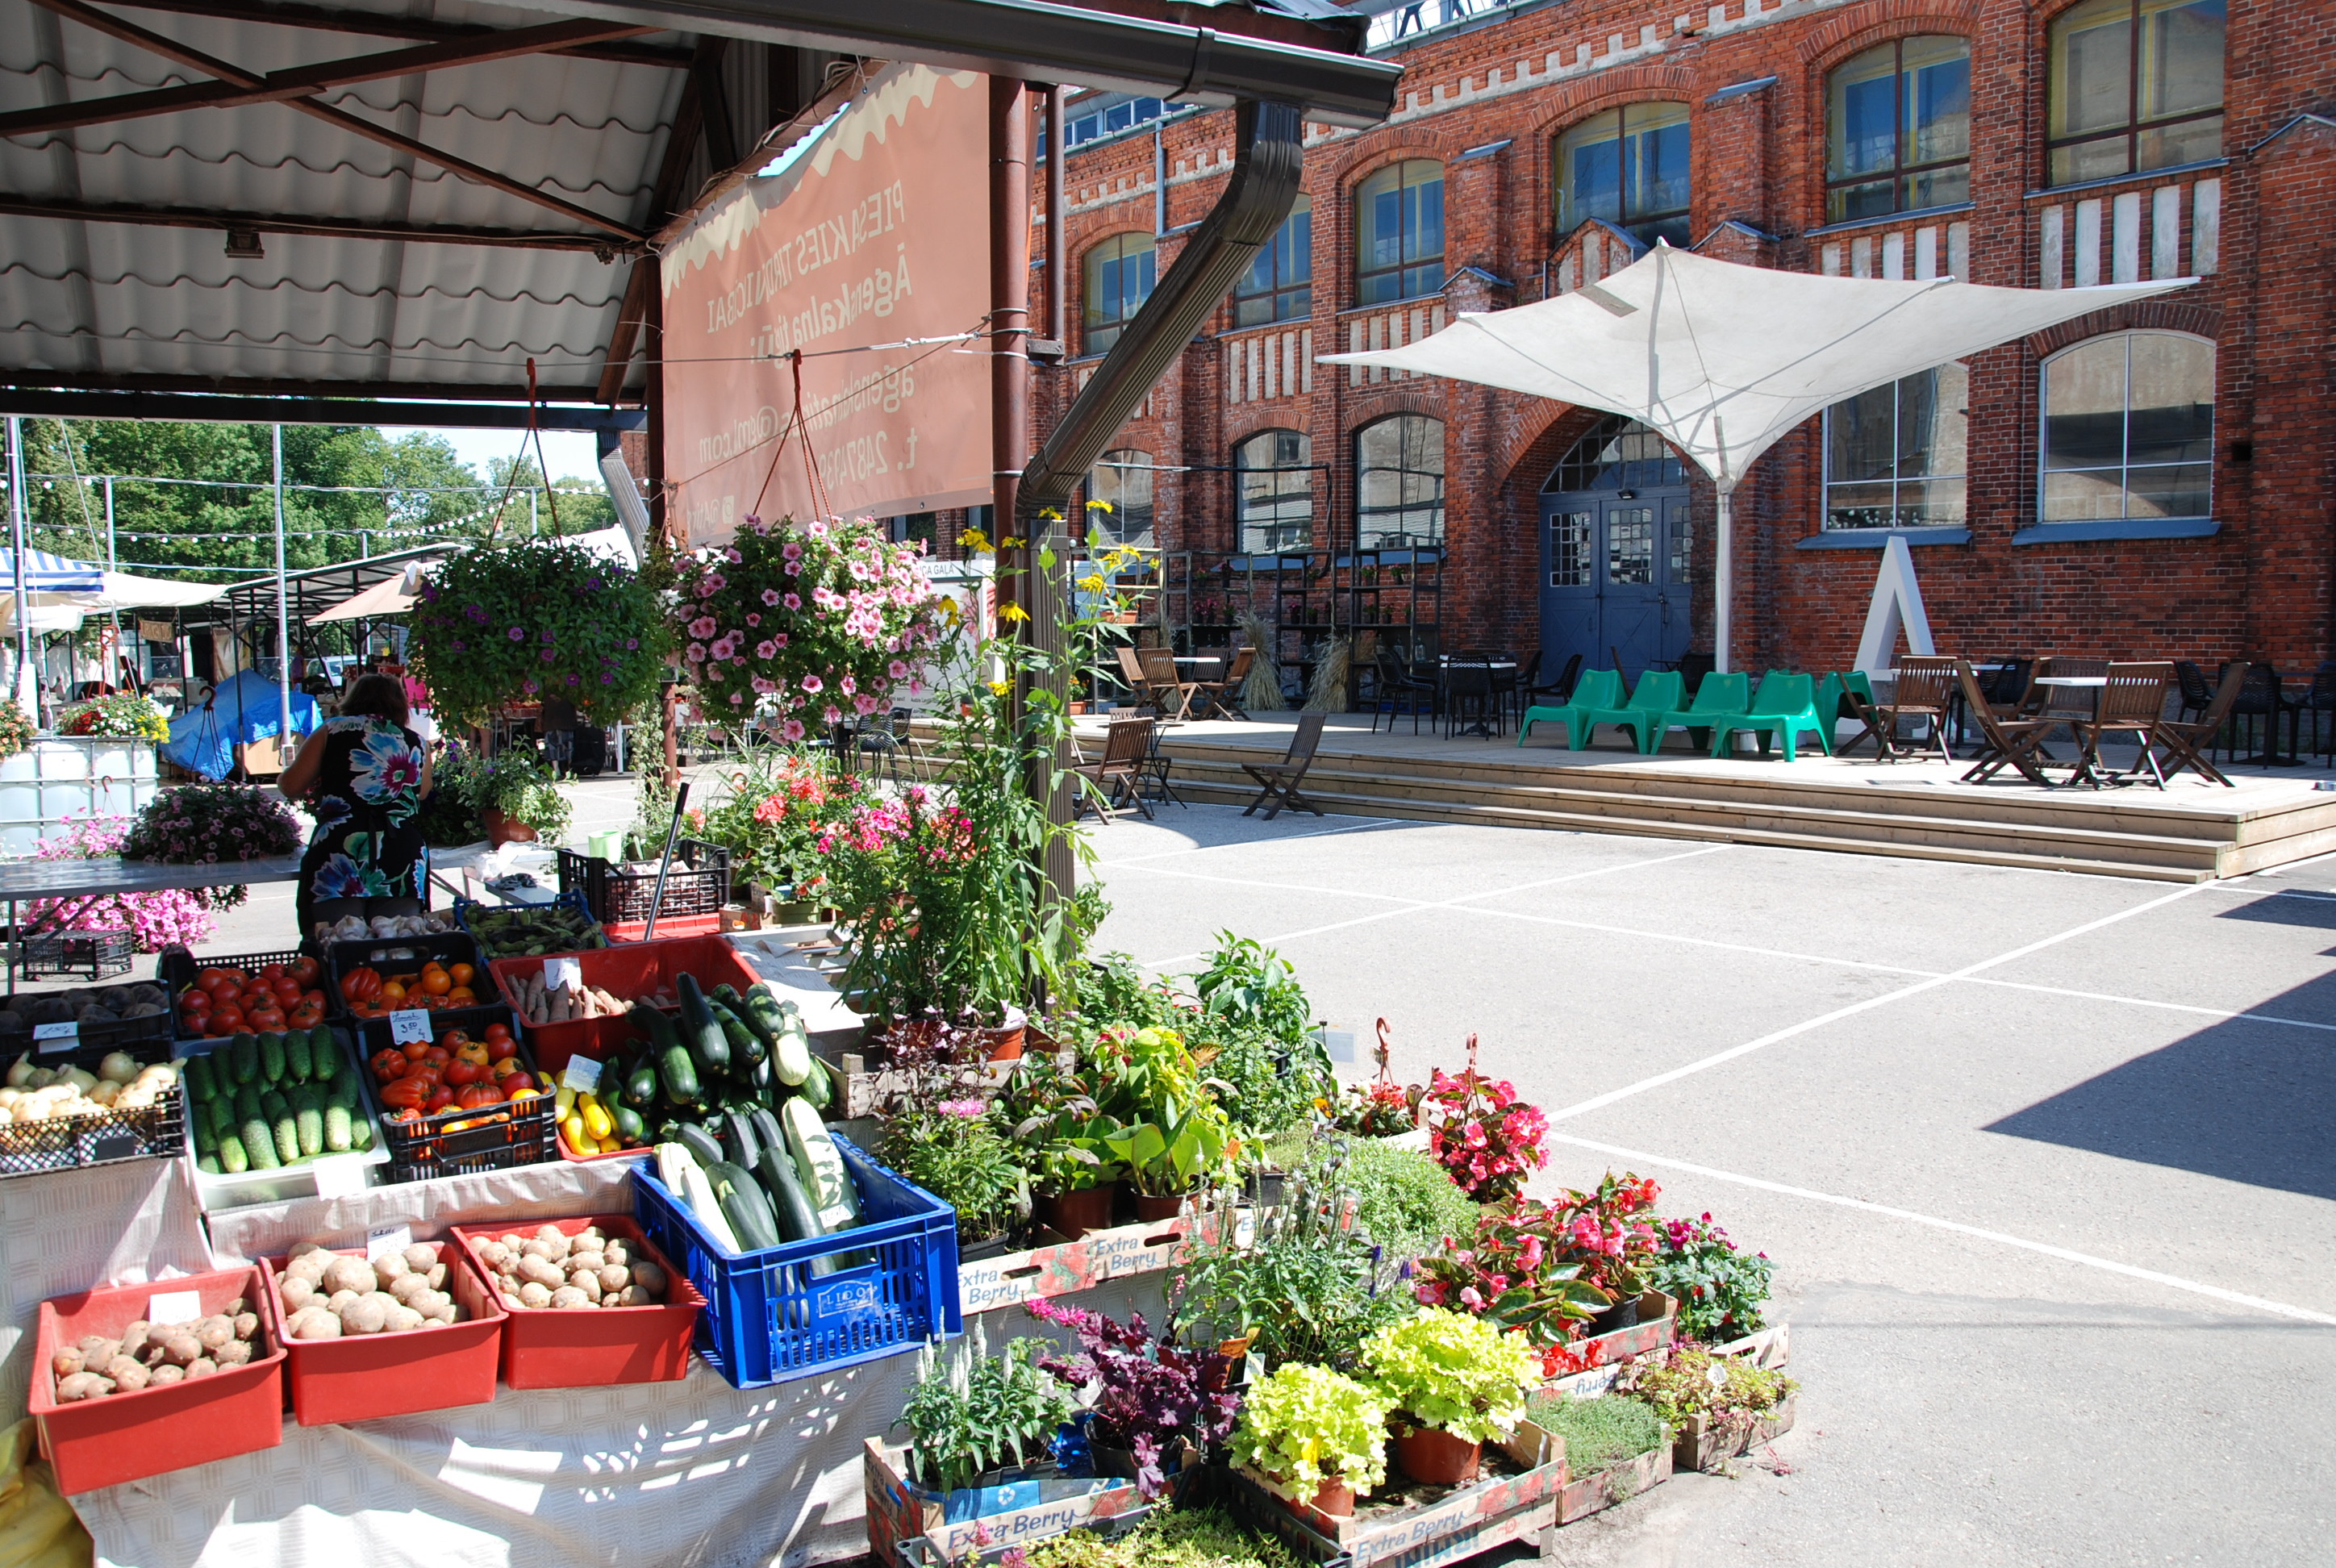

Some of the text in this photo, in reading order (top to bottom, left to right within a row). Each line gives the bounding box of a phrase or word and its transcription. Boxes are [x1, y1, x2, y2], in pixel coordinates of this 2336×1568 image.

[1096, 1236, 1138, 1256] Extra
[1111, 1251, 1160, 1271] Berry
[826, 1287, 866, 1305] LIDO
[968, 1283, 1020, 1305] Berry
[947, 1507, 1079, 1549] Exra Berry
[1355, 1510, 1467, 1562] Extra Berry
